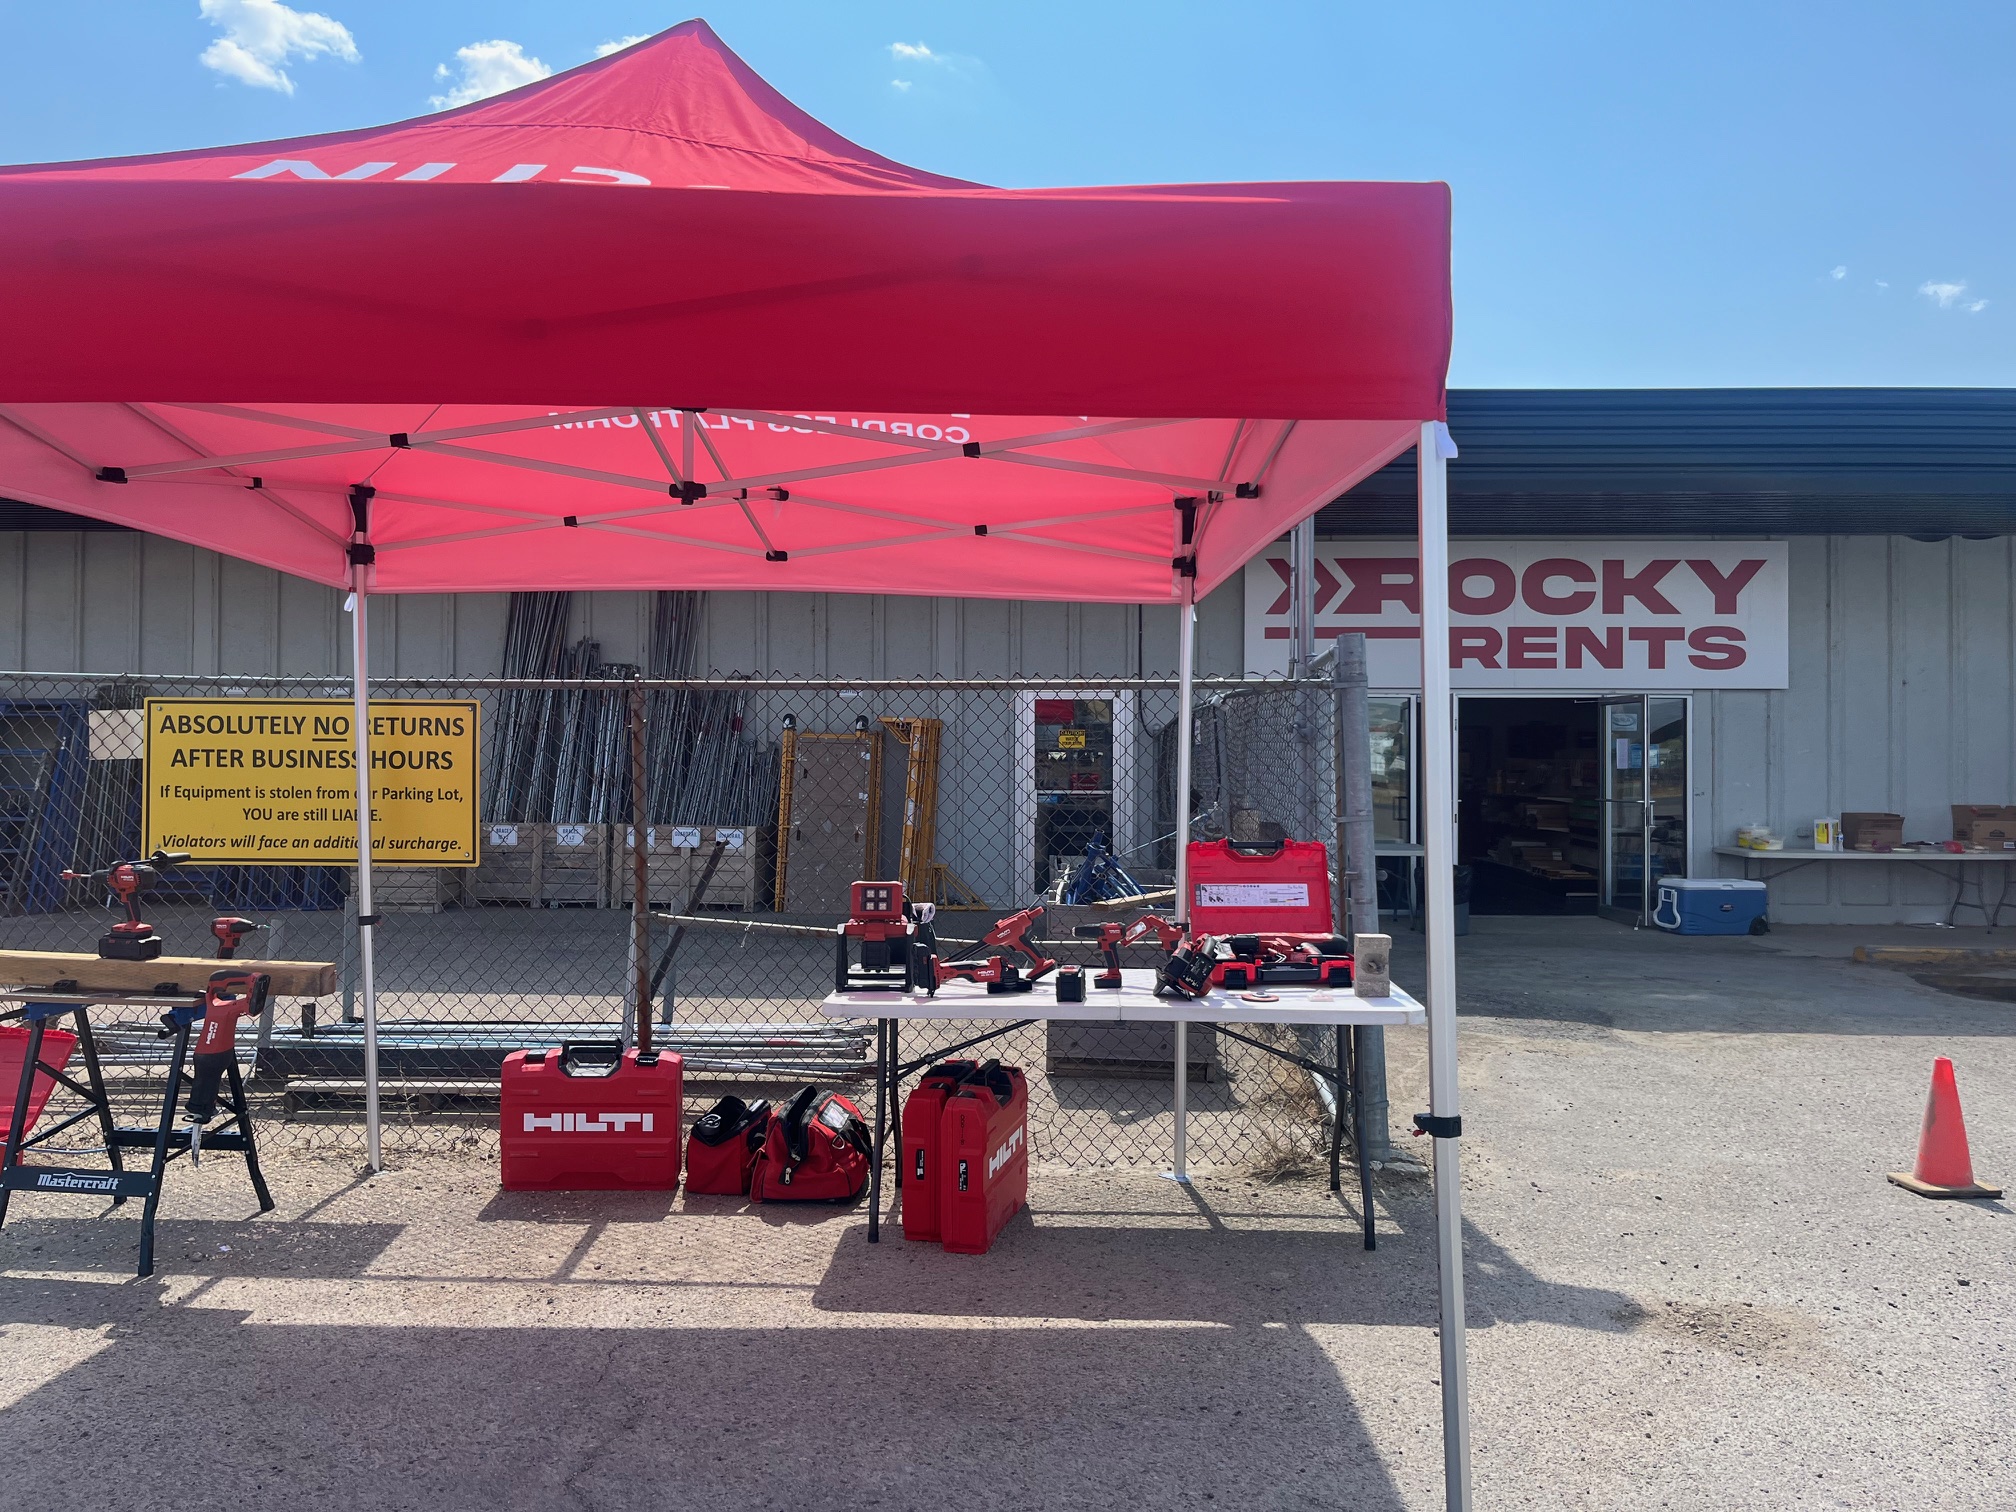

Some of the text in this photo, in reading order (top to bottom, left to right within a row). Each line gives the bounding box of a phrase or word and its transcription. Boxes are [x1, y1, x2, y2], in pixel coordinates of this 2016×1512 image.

[1333, 558, 1768, 616] ROCKY
[1449, 625, 1747, 671] RENTS
[159, 714, 465, 737] ABSOLUTELY NO ETURNS
[171, 748, 245, 768] AFTER
[371, 750, 454, 770] HOURS
[160, 785, 171, 798] If
[174, 785, 251, 802] Equipment
[255, 785, 266, 798] is
[269, 785, 312, 799] stolen
[316, 785, 350, 800] from
[382, 786, 434, 803] Parking
[437, 787, 464, 803] Lot,
[243, 807, 383, 822] YOU are still LIAE.
[161, 834, 462, 853] Violators will face an additial surcharge.
[523, 1112, 654, 1132] HILTI
[988, 1125, 1023, 1179] HILTI
[37, 1173, 119, 1190] Mastercraft
